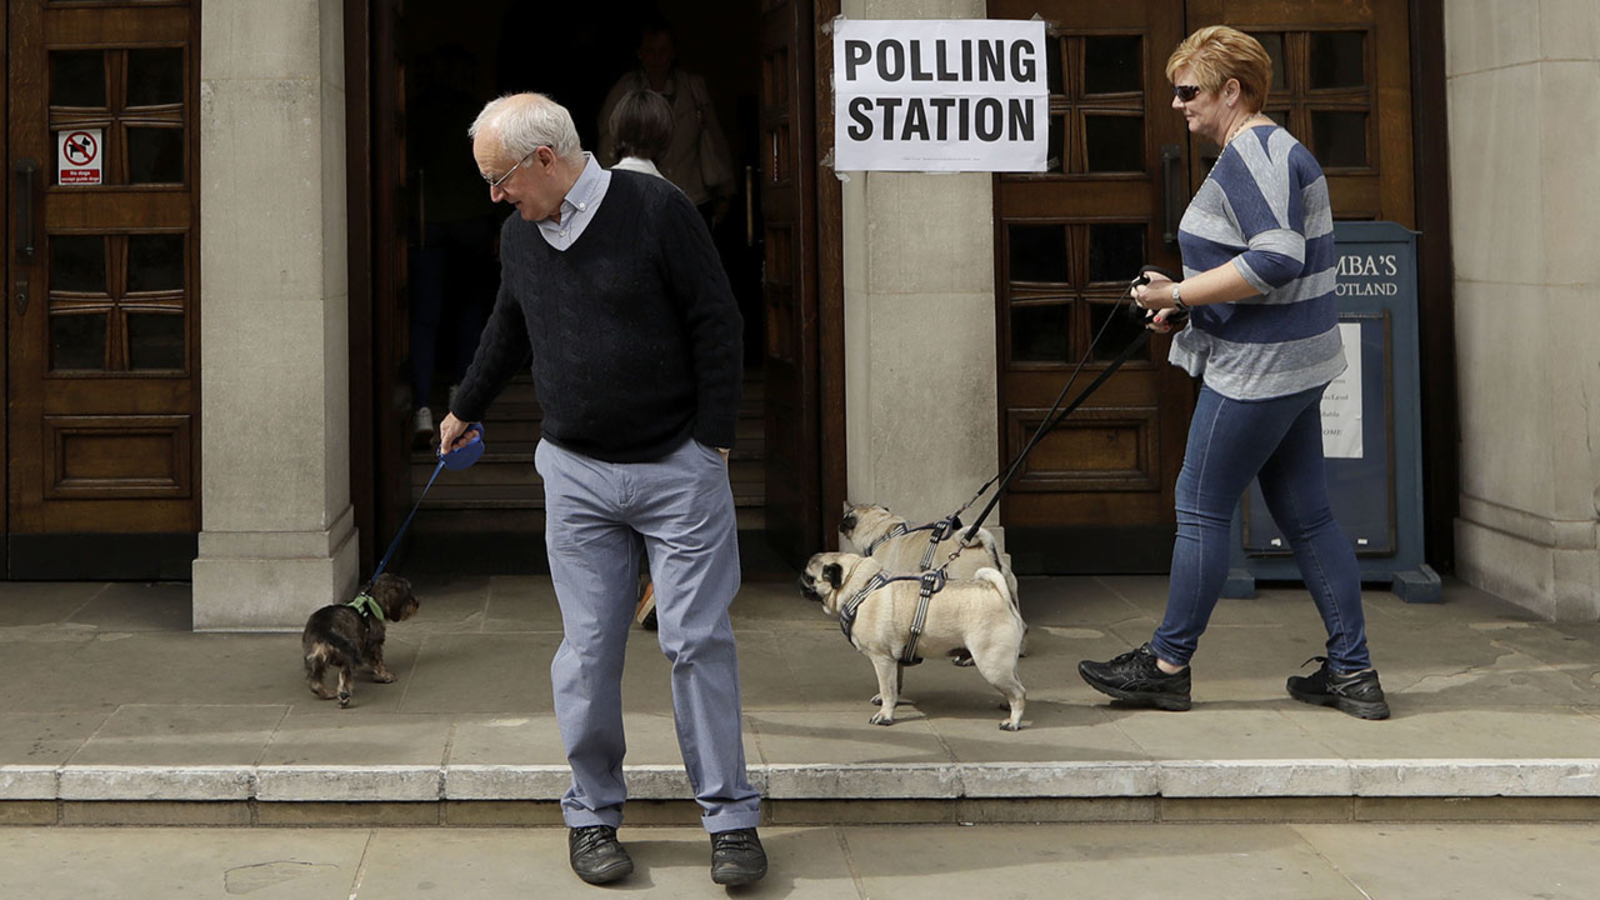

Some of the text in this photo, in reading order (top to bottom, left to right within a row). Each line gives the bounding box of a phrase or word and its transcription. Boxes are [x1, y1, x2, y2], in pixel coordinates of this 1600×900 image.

[844, 39, 1036, 82] POLLING
[847, 97, 1035, 141] STATION
[1334, 255, 1397, 276] MBA'S
[1335, 282, 1398, 296] OTLAND
